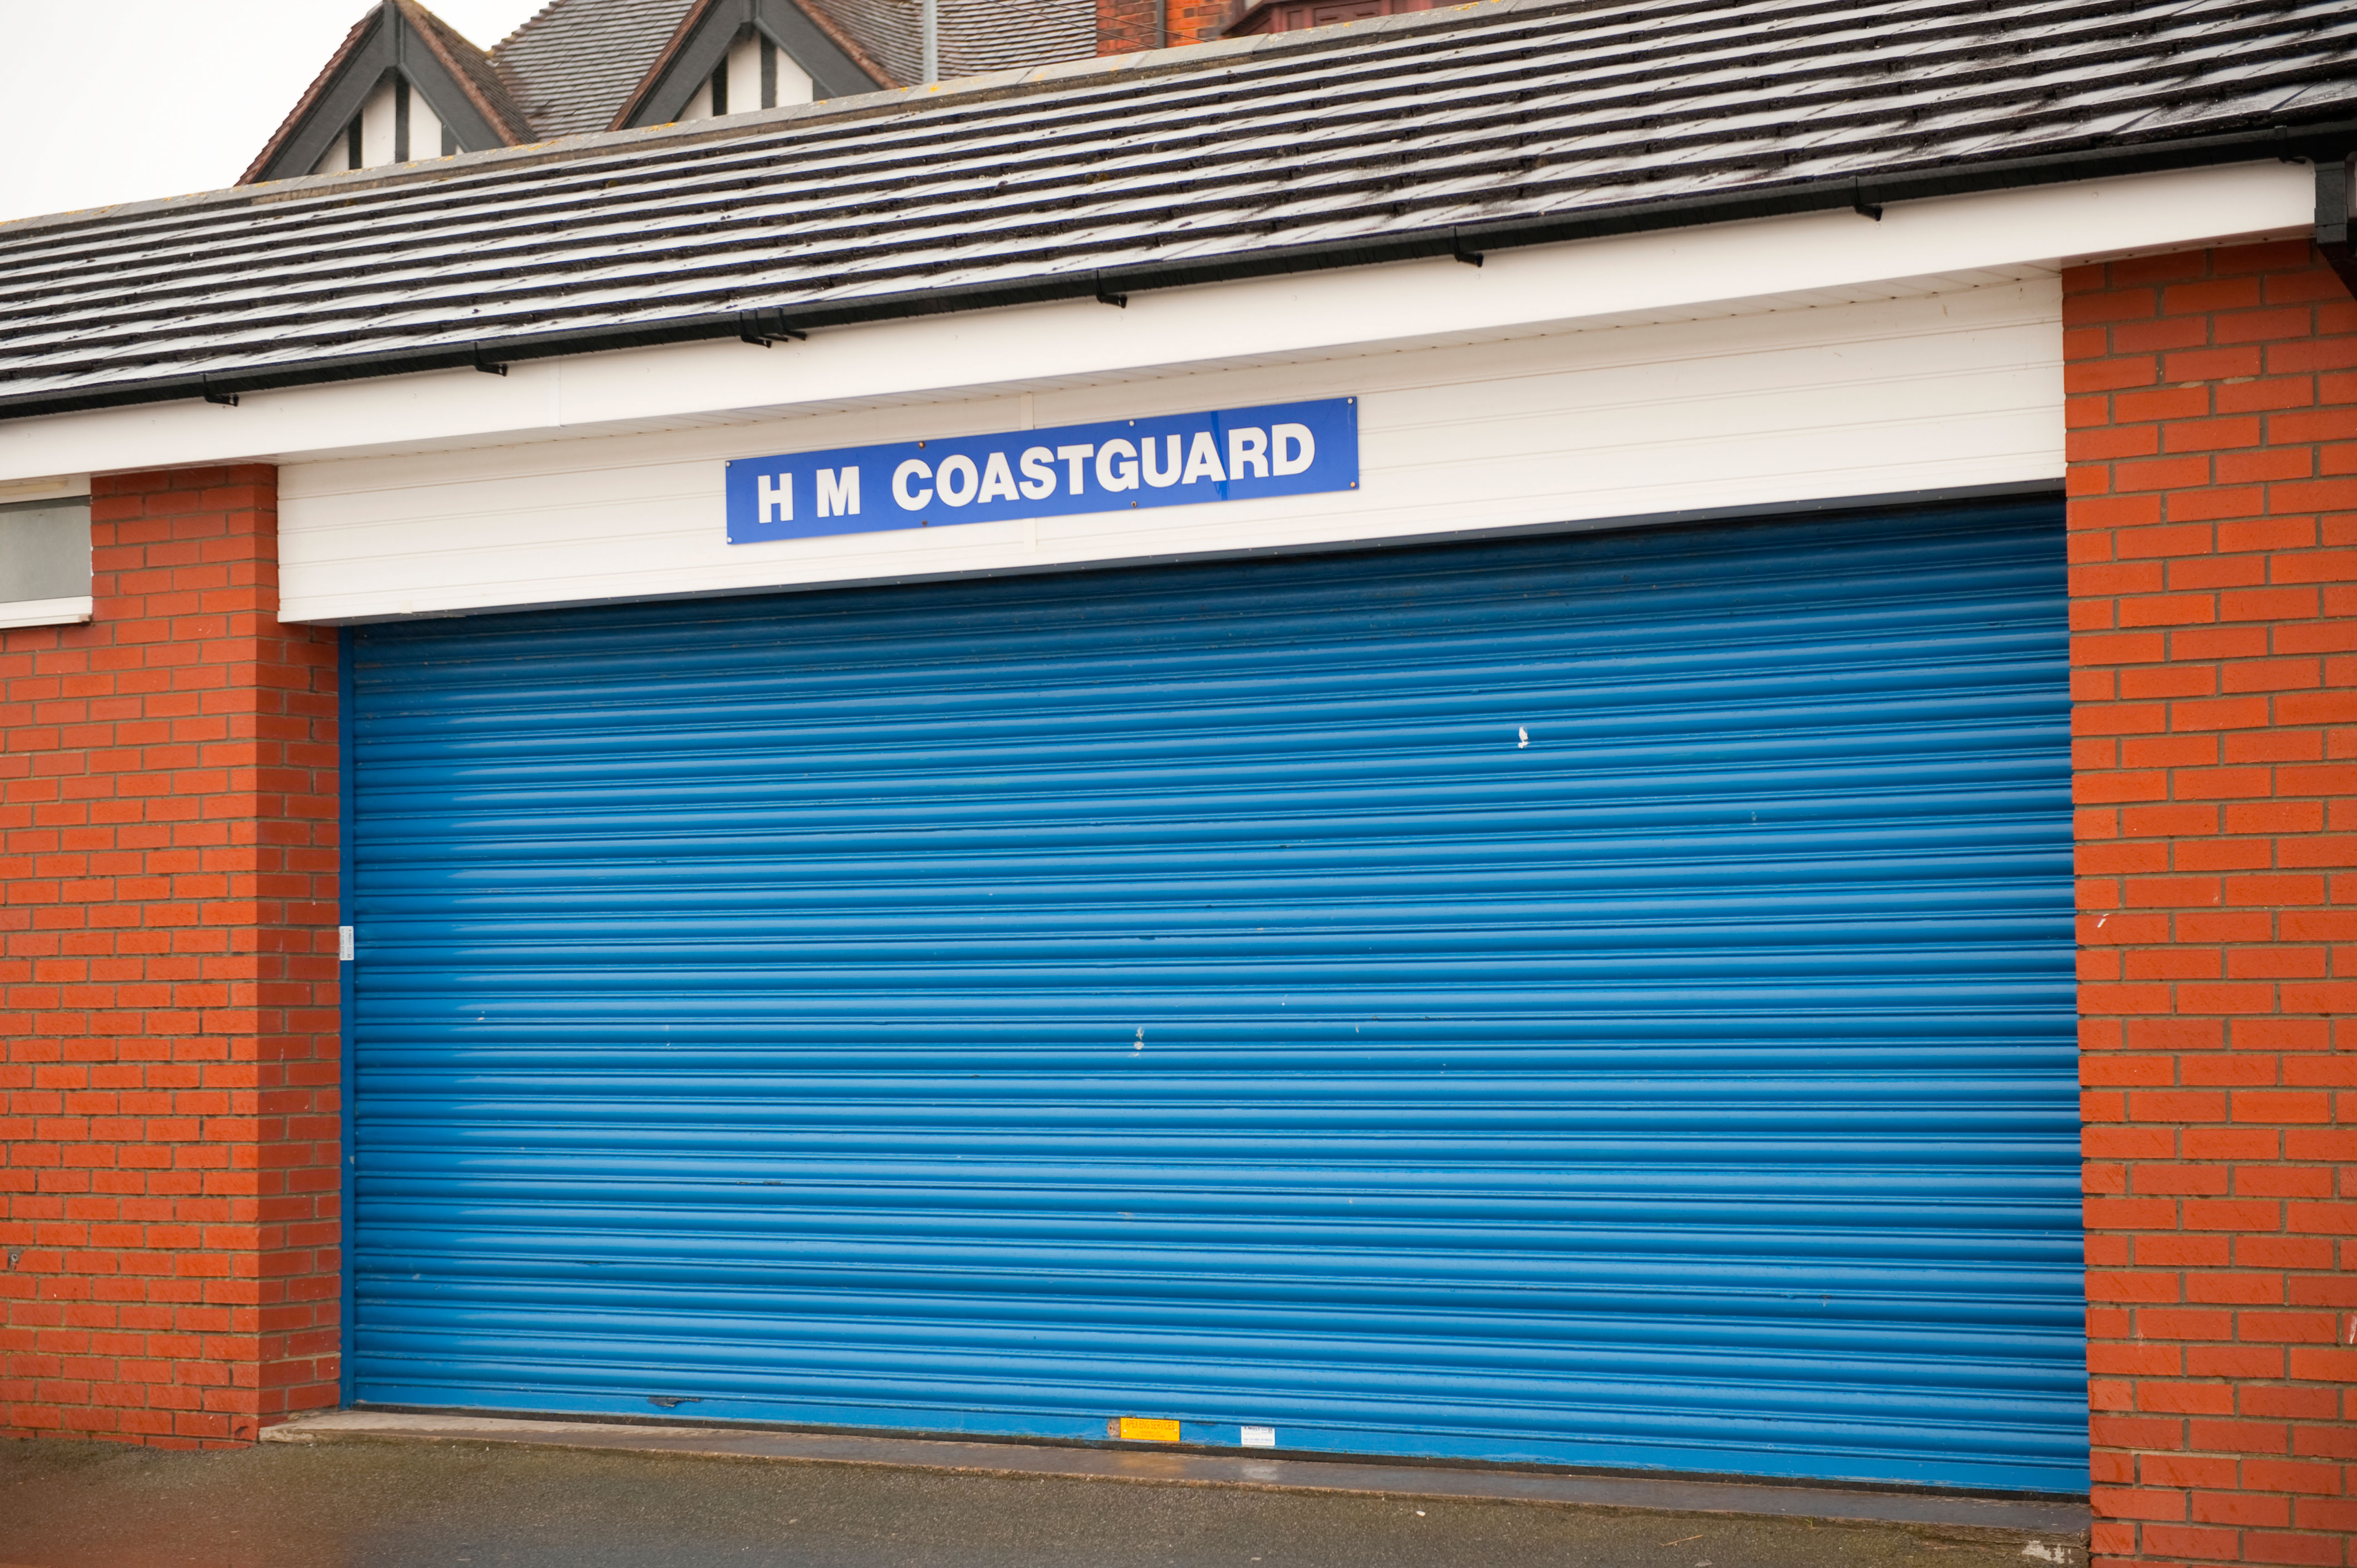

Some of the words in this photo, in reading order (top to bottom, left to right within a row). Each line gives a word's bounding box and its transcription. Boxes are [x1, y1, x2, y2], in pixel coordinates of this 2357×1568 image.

[757, 473, 794, 524] H
[816, 466, 860, 518] M
[892, 423, 1315, 511] COASTGUARD
[1126, 1419, 1138, 1428] APEX
[1140, 1420, 1149, 1429] ENG
[1151, 1420, 1174, 1430] SERVICES
